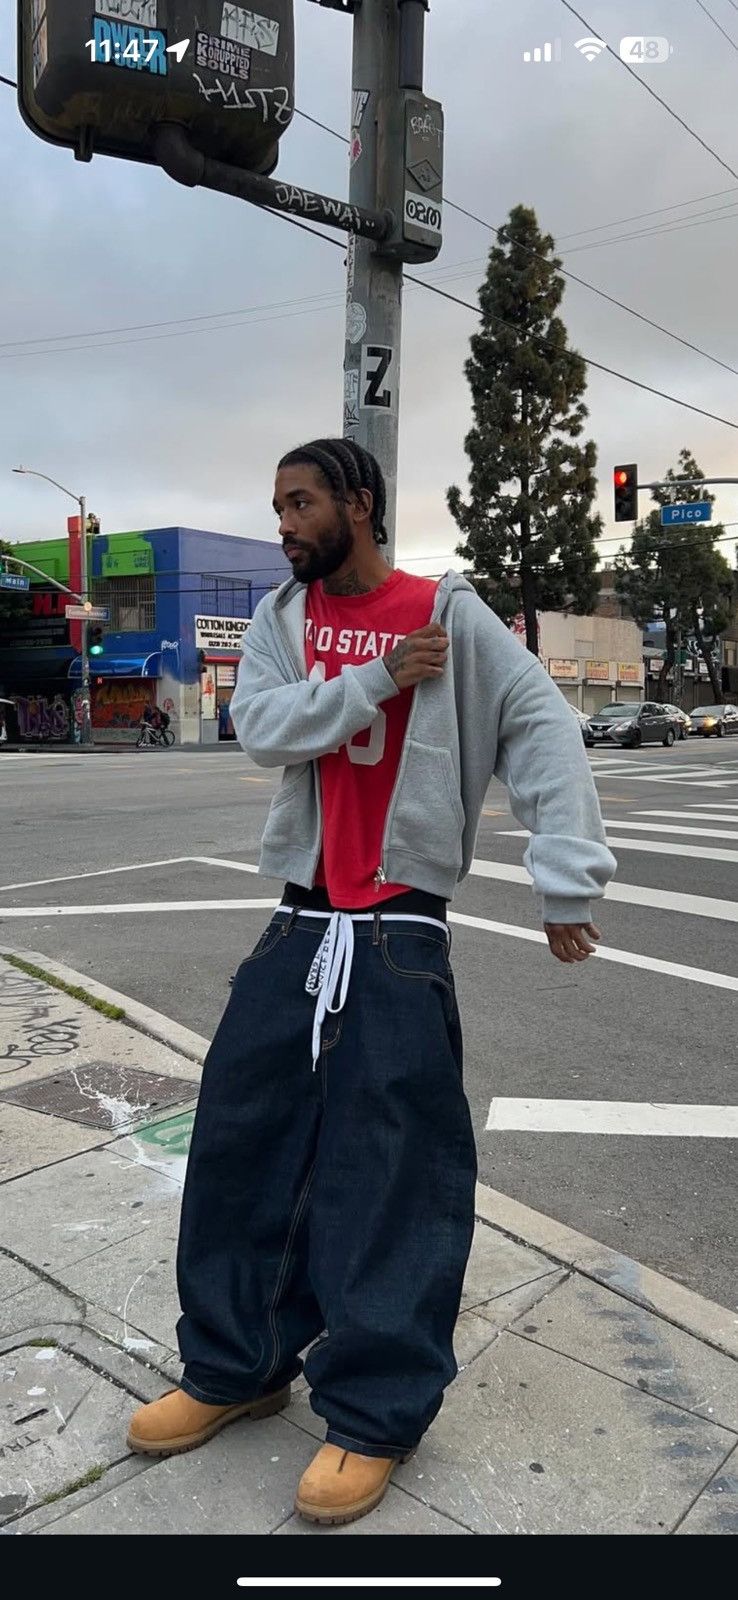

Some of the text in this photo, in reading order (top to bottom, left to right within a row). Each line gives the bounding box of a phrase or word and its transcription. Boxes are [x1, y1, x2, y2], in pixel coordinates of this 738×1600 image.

[197, 33, 251, 58] CRIME
[196, 56, 249, 80] SOULS
[364, 346, 393, 408] Z
[671, 508, 702, 520] Pico
[5, 577, 25, 586] Main
[196, 618, 225, 631] COTTON
